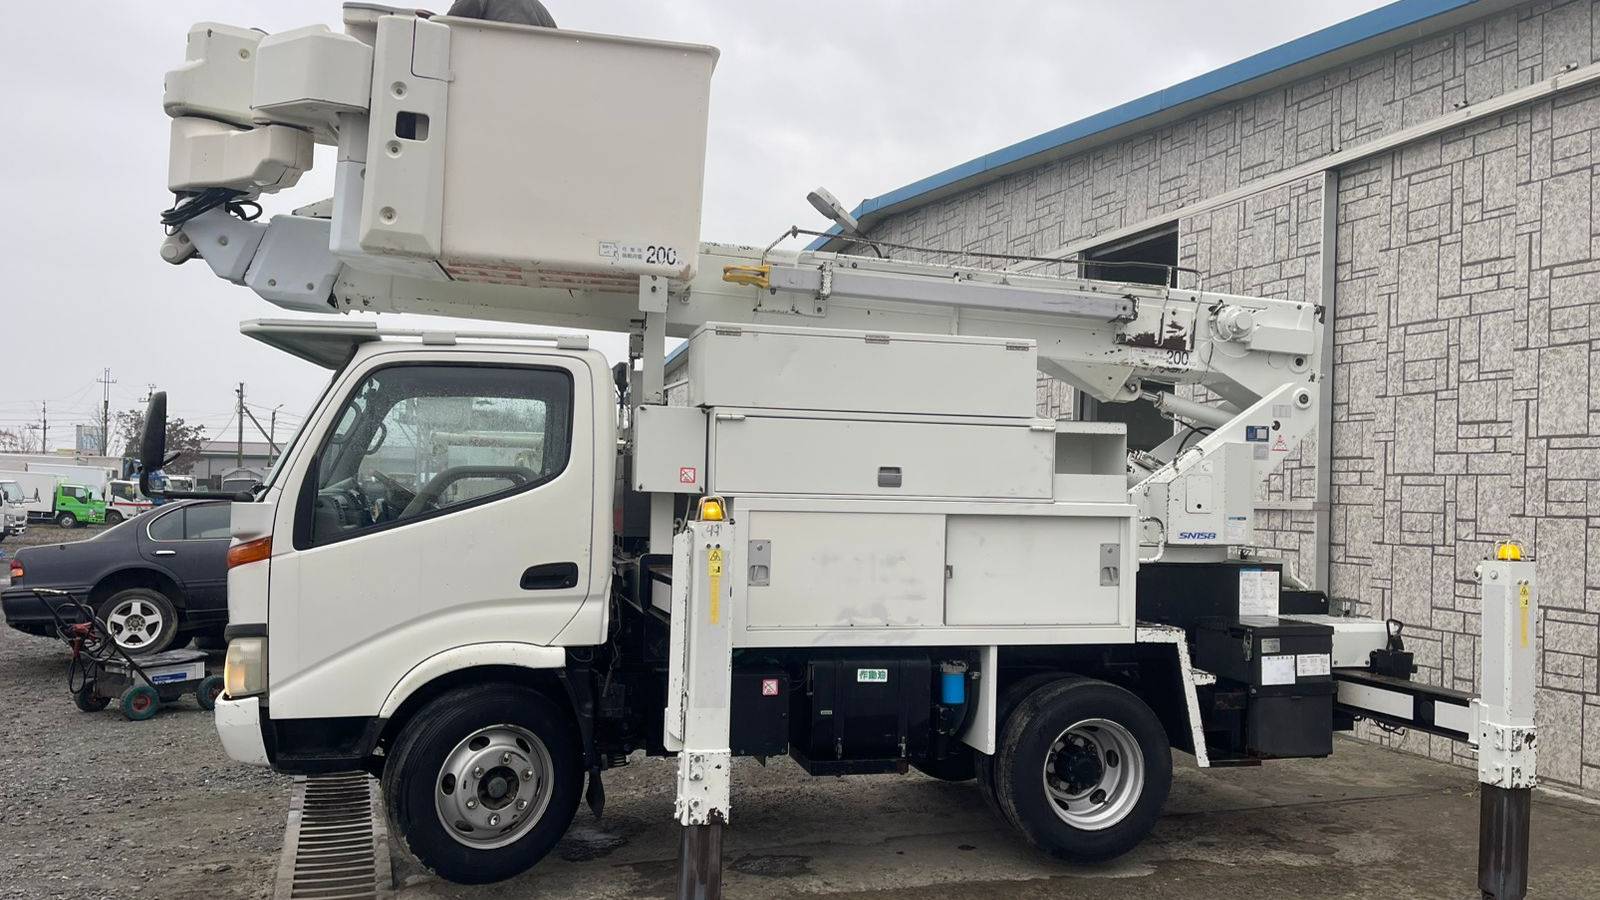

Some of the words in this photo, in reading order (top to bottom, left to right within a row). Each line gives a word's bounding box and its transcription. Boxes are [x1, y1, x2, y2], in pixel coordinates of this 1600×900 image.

[646, 245, 677, 265] 200
[1166, 350, 1189, 365] 200
[859, 671, 886, 680] 作動油
